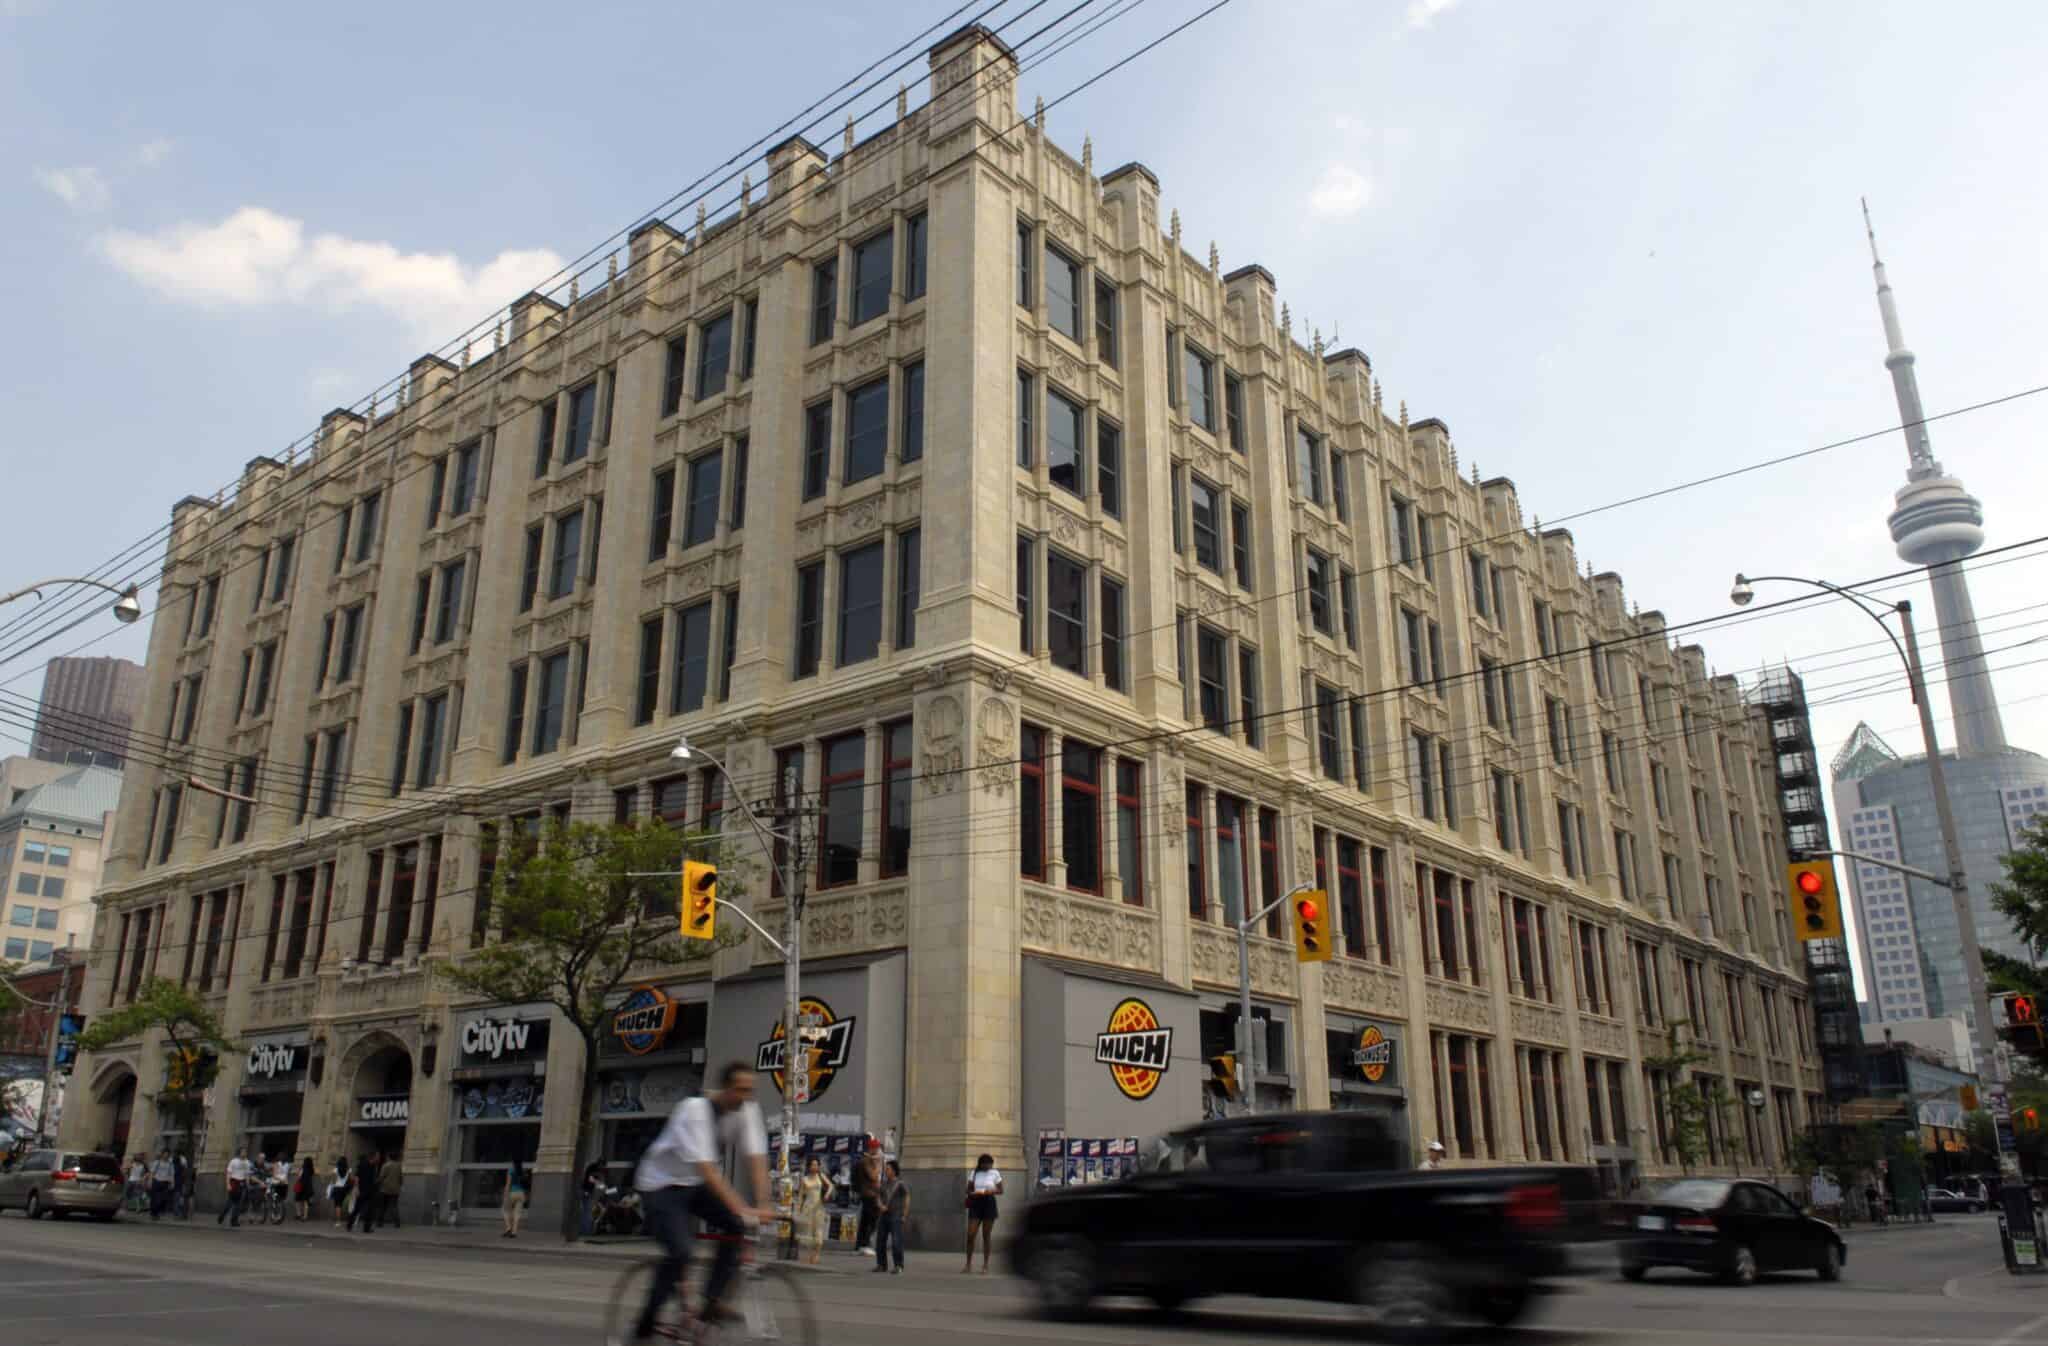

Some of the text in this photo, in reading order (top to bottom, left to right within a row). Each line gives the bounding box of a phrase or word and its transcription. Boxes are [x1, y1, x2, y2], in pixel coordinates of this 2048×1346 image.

[616, 1005, 667, 1031] MUCH
[462, 1019, 529, 1059] Citytv
[1099, 1033, 1168, 1065] MUCH
[247, 1044, 295, 1078] Citytv
[360, 1100, 409, 1120] CHUM
